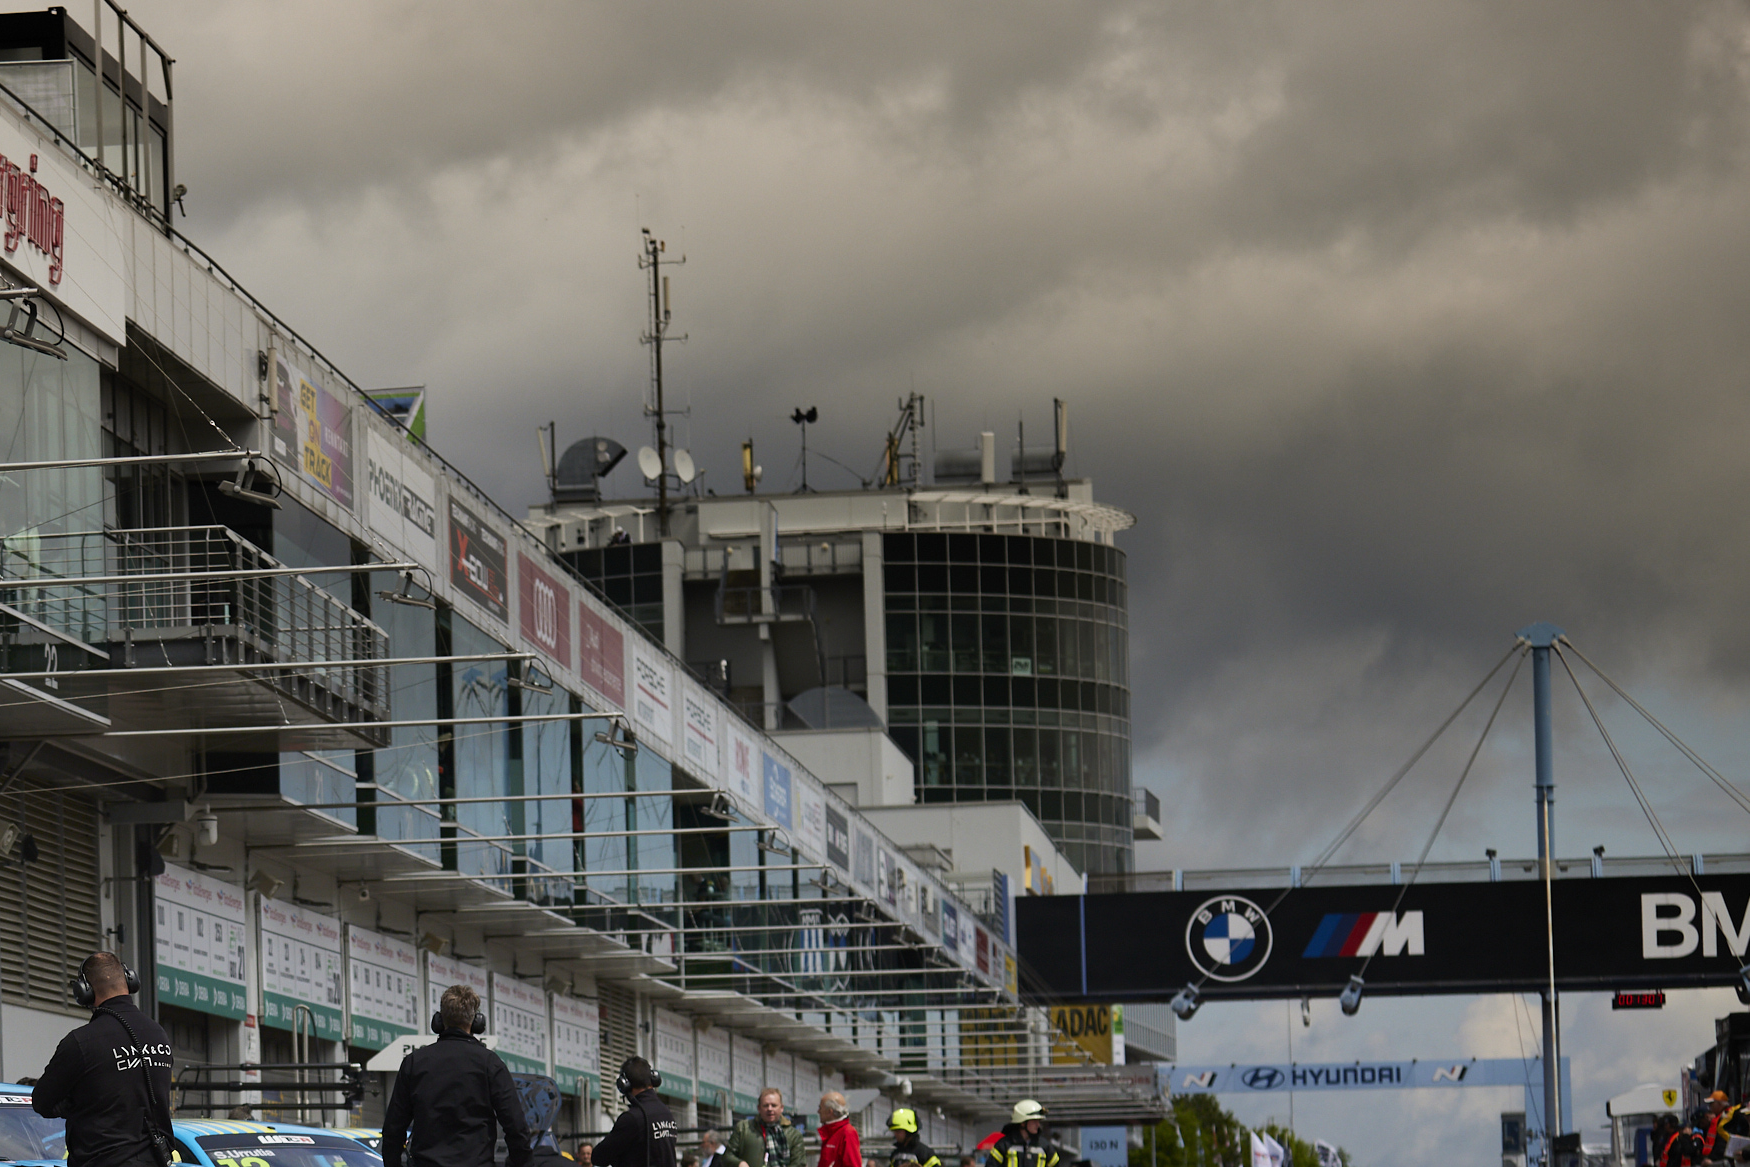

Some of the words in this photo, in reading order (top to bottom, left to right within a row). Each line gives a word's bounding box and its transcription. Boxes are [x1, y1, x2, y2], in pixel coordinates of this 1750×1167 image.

[300, 381, 317, 414] GET
[308, 419, 321, 448] ON
[304, 445, 332, 488] TRACK
[43, 642, 58, 690] 22
[1197, 900, 1261, 926] BMW
[1056, 1006, 1109, 1038] ADAC
[1291, 1066, 1402, 1087] HYUNDAI
[213, 1149, 276, 1160] S.Urrutia
[1107, 1140, 1119, 1150] N
